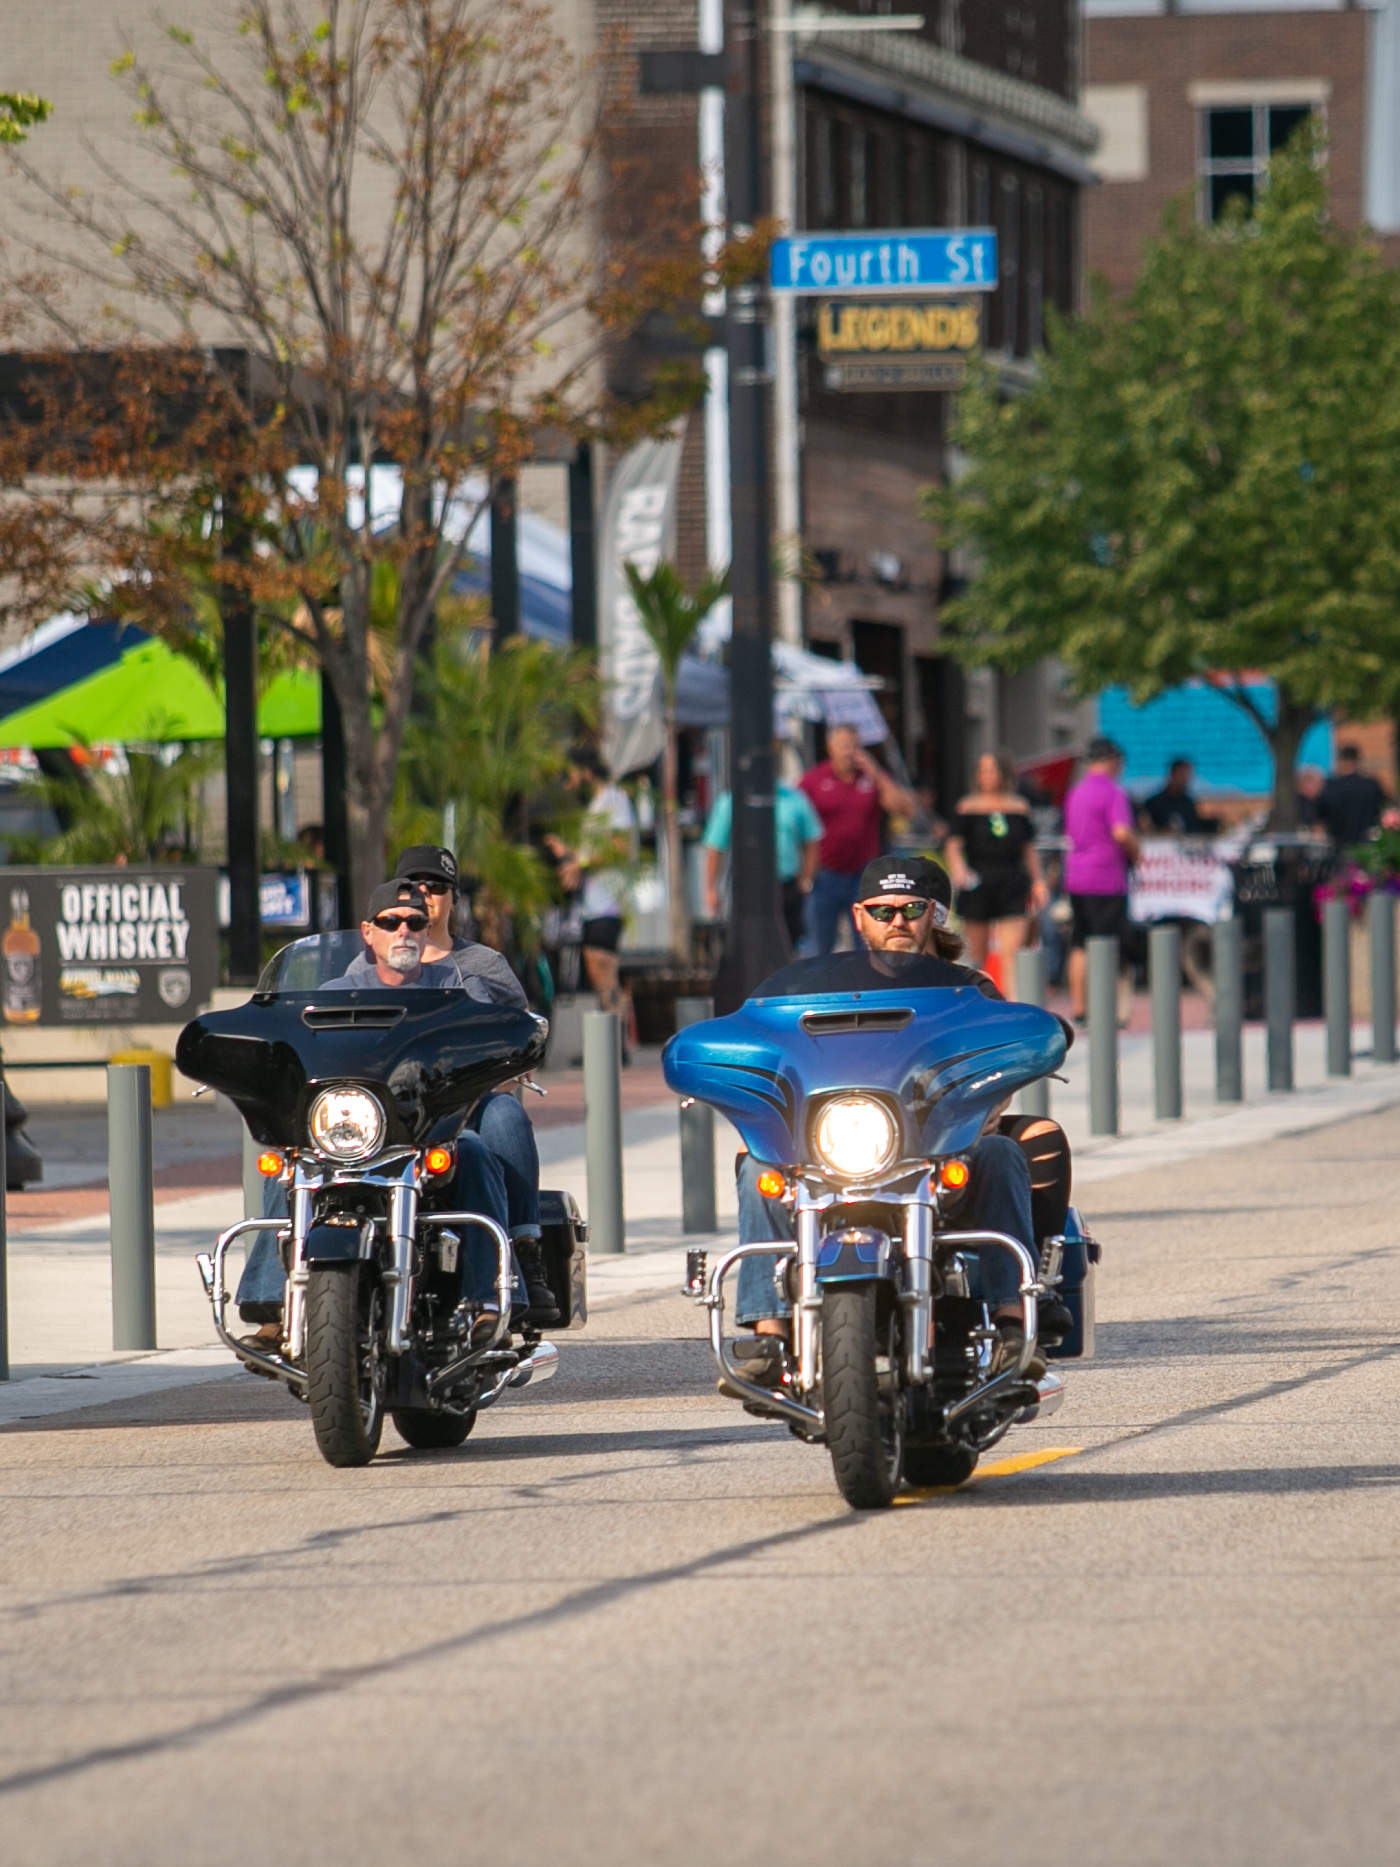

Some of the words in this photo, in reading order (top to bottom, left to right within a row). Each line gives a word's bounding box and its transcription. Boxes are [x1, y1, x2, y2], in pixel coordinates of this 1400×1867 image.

[788, 242, 920, 285] Fourth
[946, 239, 985, 282] St
[817, 302, 980, 350] LEGENDS
[61, 882, 186, 923] OFFICIAL
[55, 919, 190, 961] WHISKEY
